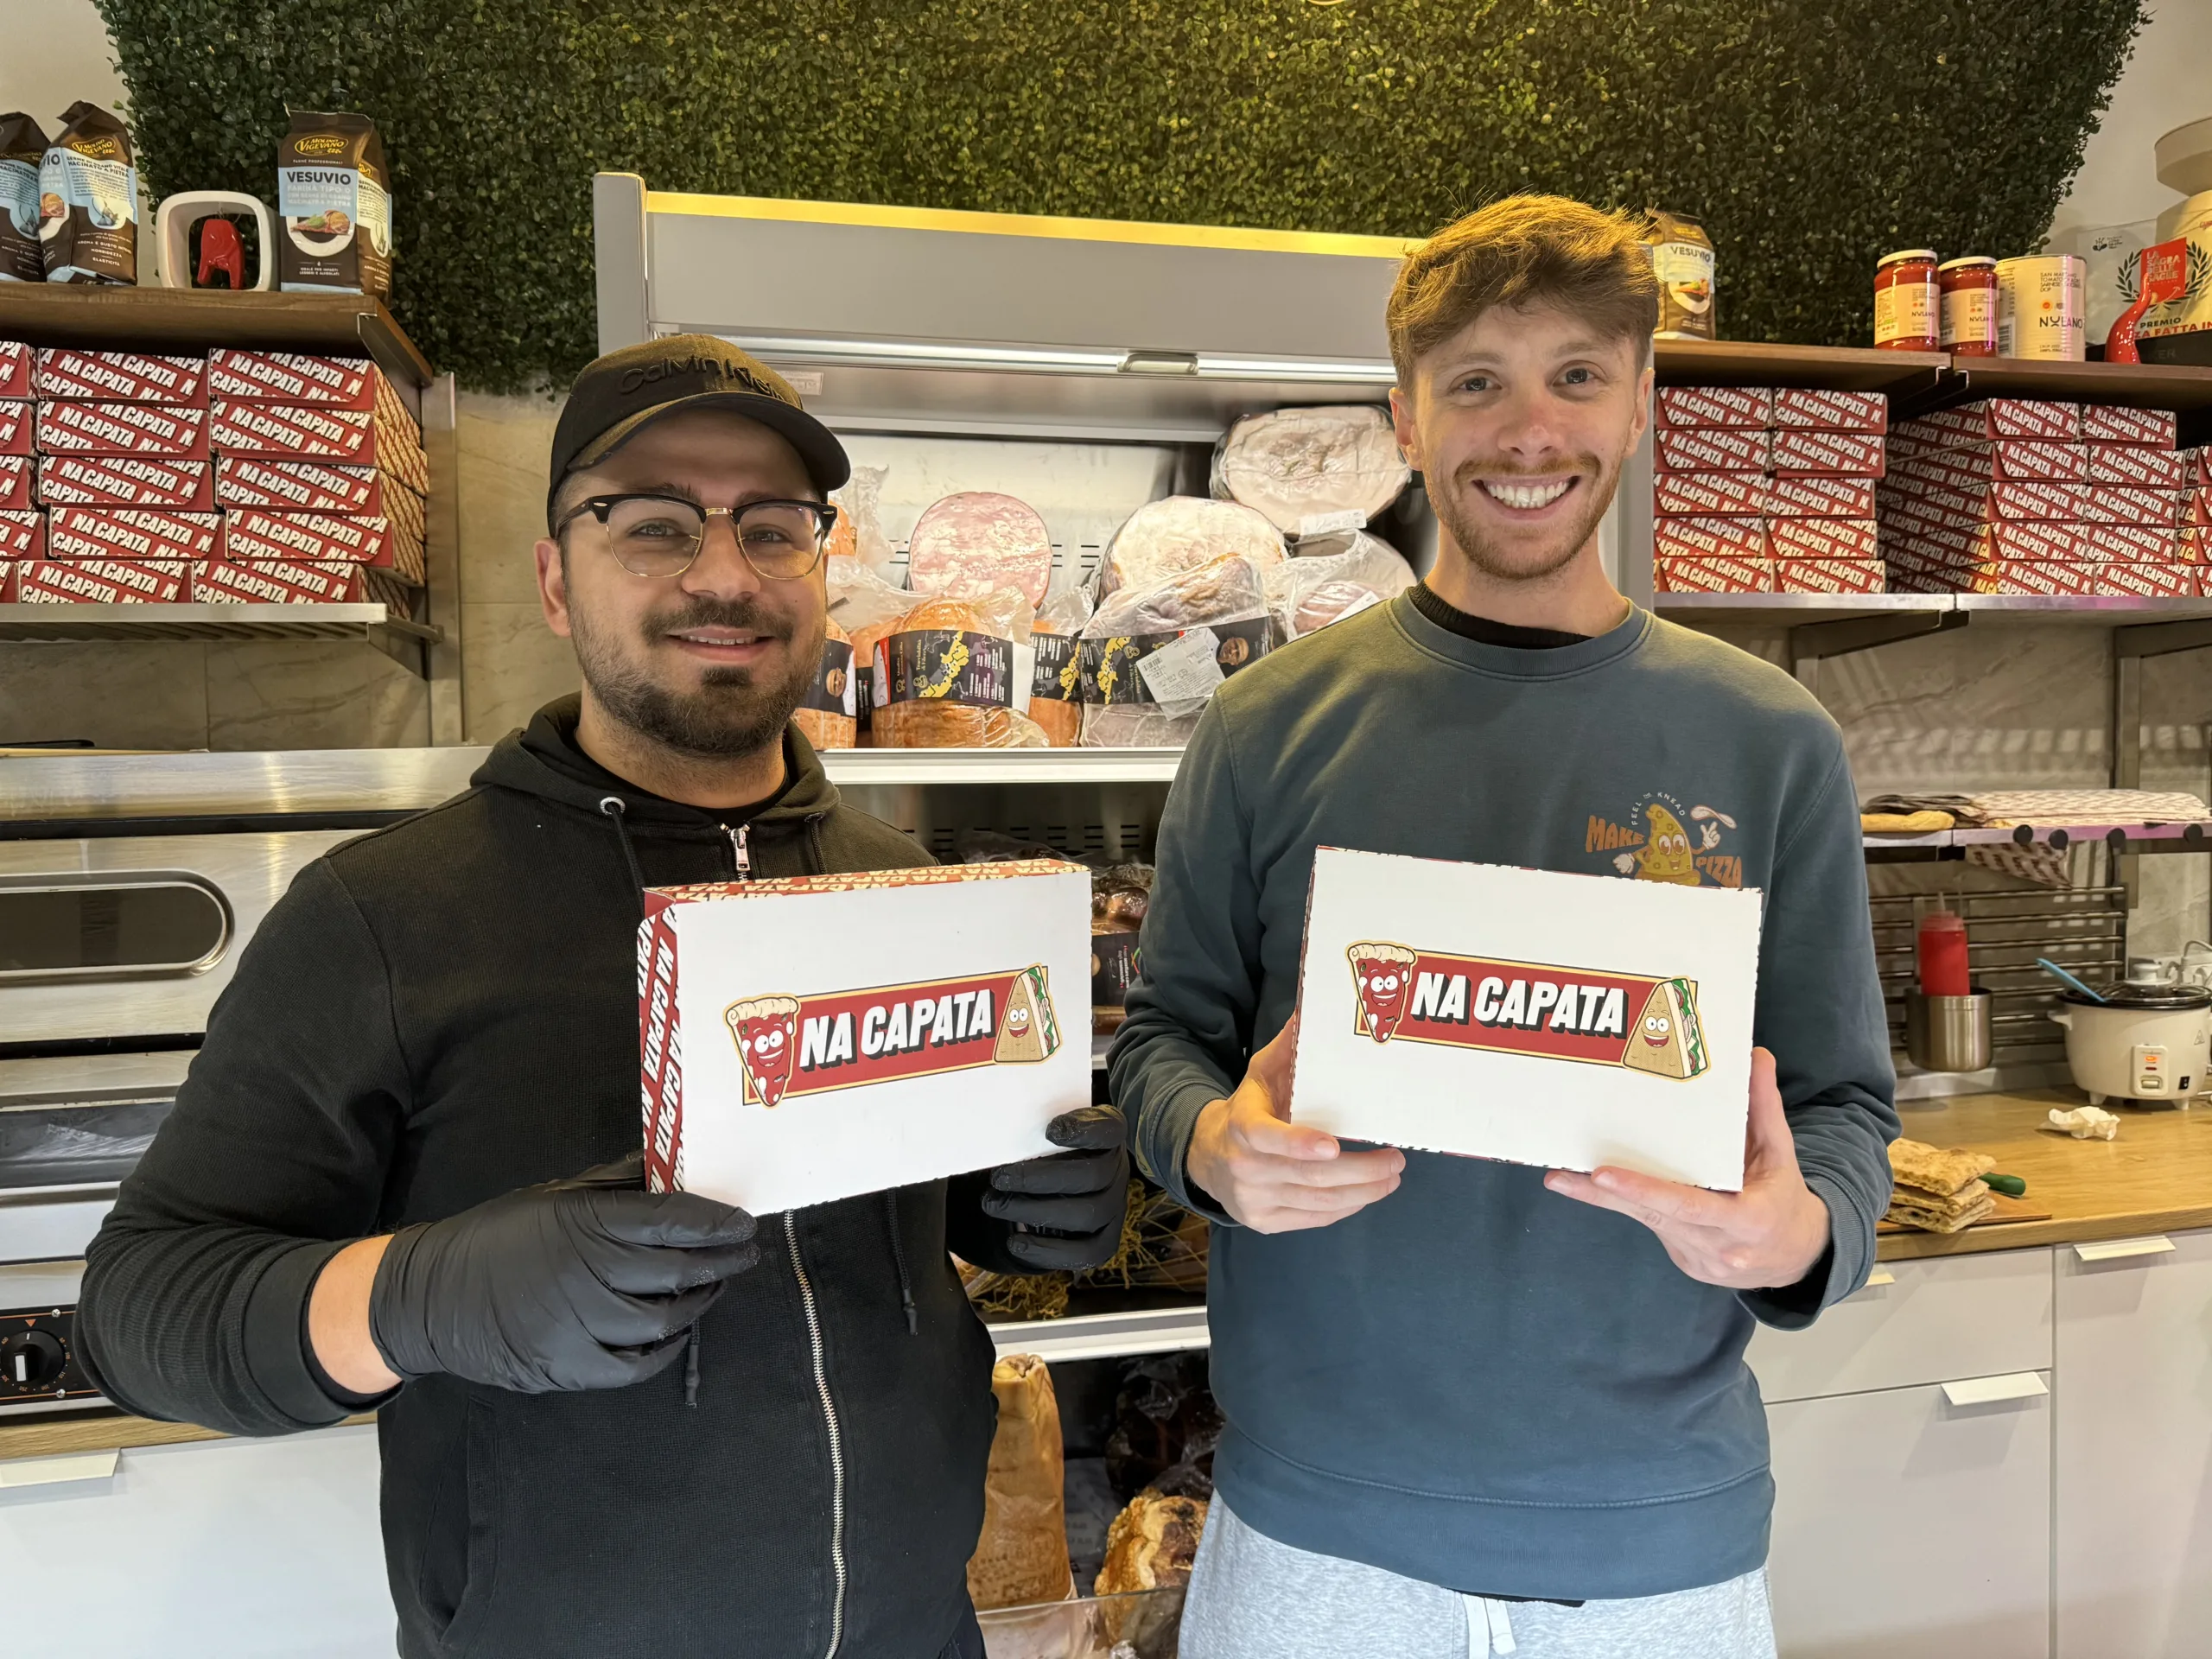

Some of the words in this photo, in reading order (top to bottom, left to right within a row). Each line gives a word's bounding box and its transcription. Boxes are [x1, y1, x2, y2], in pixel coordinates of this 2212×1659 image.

[75, 141, 112, 154] VIGEVANO
[299, 140, 345, 151] VIGEVANO
[68, 161, 103, 171] MACINATO
[287, 171, 351, 185] VESUVIO
[1670, 245, 1711, 263] VESUVIO
[2139, 317, 2181, 328] PREMIO
[2154, 323, 2197, 337] FATTA
[58, 353, 83, 375] NA
[80, 363, 136, 397] CAPATA
[100, 353, 124, 366] NA
[123, 356, 176, 387] CAPATA
[228, 353, 252, 374] NA
[250, 363, 304, 396] CAPATA
[270, 353, 292, 366] NA
[291, 356, 343, 387] CAPATA
[619, 355, 721, 395] Calvin
[99, 404, 124, 418] NA
[122, 407, 175, 438] CAPATA
[1672, 390, 1688, 407] NA
[1687, 397, 1724, 423] CAPATA
[1789, 391, 1804, 409] NA
[1803, 399, 1840, 425] CAPATA
[1999, 402, 2012, 418] NA
[2012, 409, 2042, 434] CAPATA
[58, 406, 83, 427] NA
[80, 416, 136, 448] CAPATA
[229, 406, 253, 428] NA
[251, 416, 304, 449] CAPATA
[270, 405, 293, 420] NA
[291, 410, 344, 442] CAPATA
[2094, 408, 2107, 423] NA
[2107, 415, 2139, 439] CAPATA
[1670, 433, 1686, 450] NA
[1685, 441, 1722, 466] CAPATA
[1787, 435, 1802, 452] NA
[1802, 442, 1839, 467] CAPATA
[2007, 444, 2019, 461] NA
[2019, 451, 2050, 476] CAPATA
[2102, 449, 2115, 466] NA
[2115, 456, 2146, 481] CAPATA
[60, 461, 84, 481] NA
[81, 469, 137, 500] CAPATA
[101, 458, 124, 472] NA
[124, 461, 177, 491] CAPATA
[236, 462, 260, 483] NA
[257, 472, 311, 505] CAPATA
[276, 461, 299, 475] NA
[298, 465, 350, 496] CAPATA
[1665, 477, 1681, 494] NA
[1681, 484, 1719, 509] CAPATA
[1777, 481, 1792, 498] NA
[1791, 487, 1828, 512] CAPATA
[2002, 485, 2015, 501] NA
[2015, 492, 2047, 517] CAPATA
[2094, 490, 2107, 505] NA
[2107, 497, 2139, 521] CAPATA
[71, 512, 96, 534] NA
[93, 522, 151, 554] CAPATA
[113, 510, 137, 524] NA
[137, 513, 193, 544] CAPATA
[246, 515, 270, 536] NA
[268, 524, 322, 556] CAPATA
[287, 512, 310, 526] NA
[308, 516, 362, 546] CAPATA
[1663, 521, 1679, 537] NA
[1679, 527, 1716, 552] CAPATA
[1779, 522, 1795, 539] NA
[1794, 529, 1831, 554] CAPATA
[2003, 525, 2017, 542] NA
[2016, 532, 2048, 557] CAPATA
[2092, 529, 2106, 545] NA
[2105, 536, 2138, 560] CAPATA
[38, 564, 62, 586] NA
[60, 573, 118, 597] CAPATA
[79, 561, 104, 575] NA
[103, 563, 157, 593] CAPATA
[212, 564, 236, 585] NA
[234, 573, 289, 597] CAPATA
[252, 562, 276, 575] NA
[275, 563, 327, 594] CAPATA
[1674, 561, 1689, 578] NA
[1688, 568, 1726, 593] CAPATA
[1789, 563, 1804, 581] NA
[1803, 570, 1840, 593] CAPATA
[2009, 564, 2023, 581] NA
[2023, 571, 2055, 594] CAPATA
[2107, 567, 2121, 583] NA
[2120, 574, 2153, 594] CAPATA
[1631, 802, 1643, 825] FEEL
[1657, 791, 1685, 817] KNEAD
[1586, 815, 1645, 853] MAKE
[1695, 855, 1742, 888] PIZZA
[654, 936, 674, 986] NA
[1410, 971, 1471, 1025] NA
[1473, 976, 1628, 1039] CAPATA
[642, 978, 669, 1083] CAPATA
[799, 1012, 857, 1071] NA
[861, 988, 995, 1058] CAPATA
[654, 1060, 681, 1166] CAPATA
